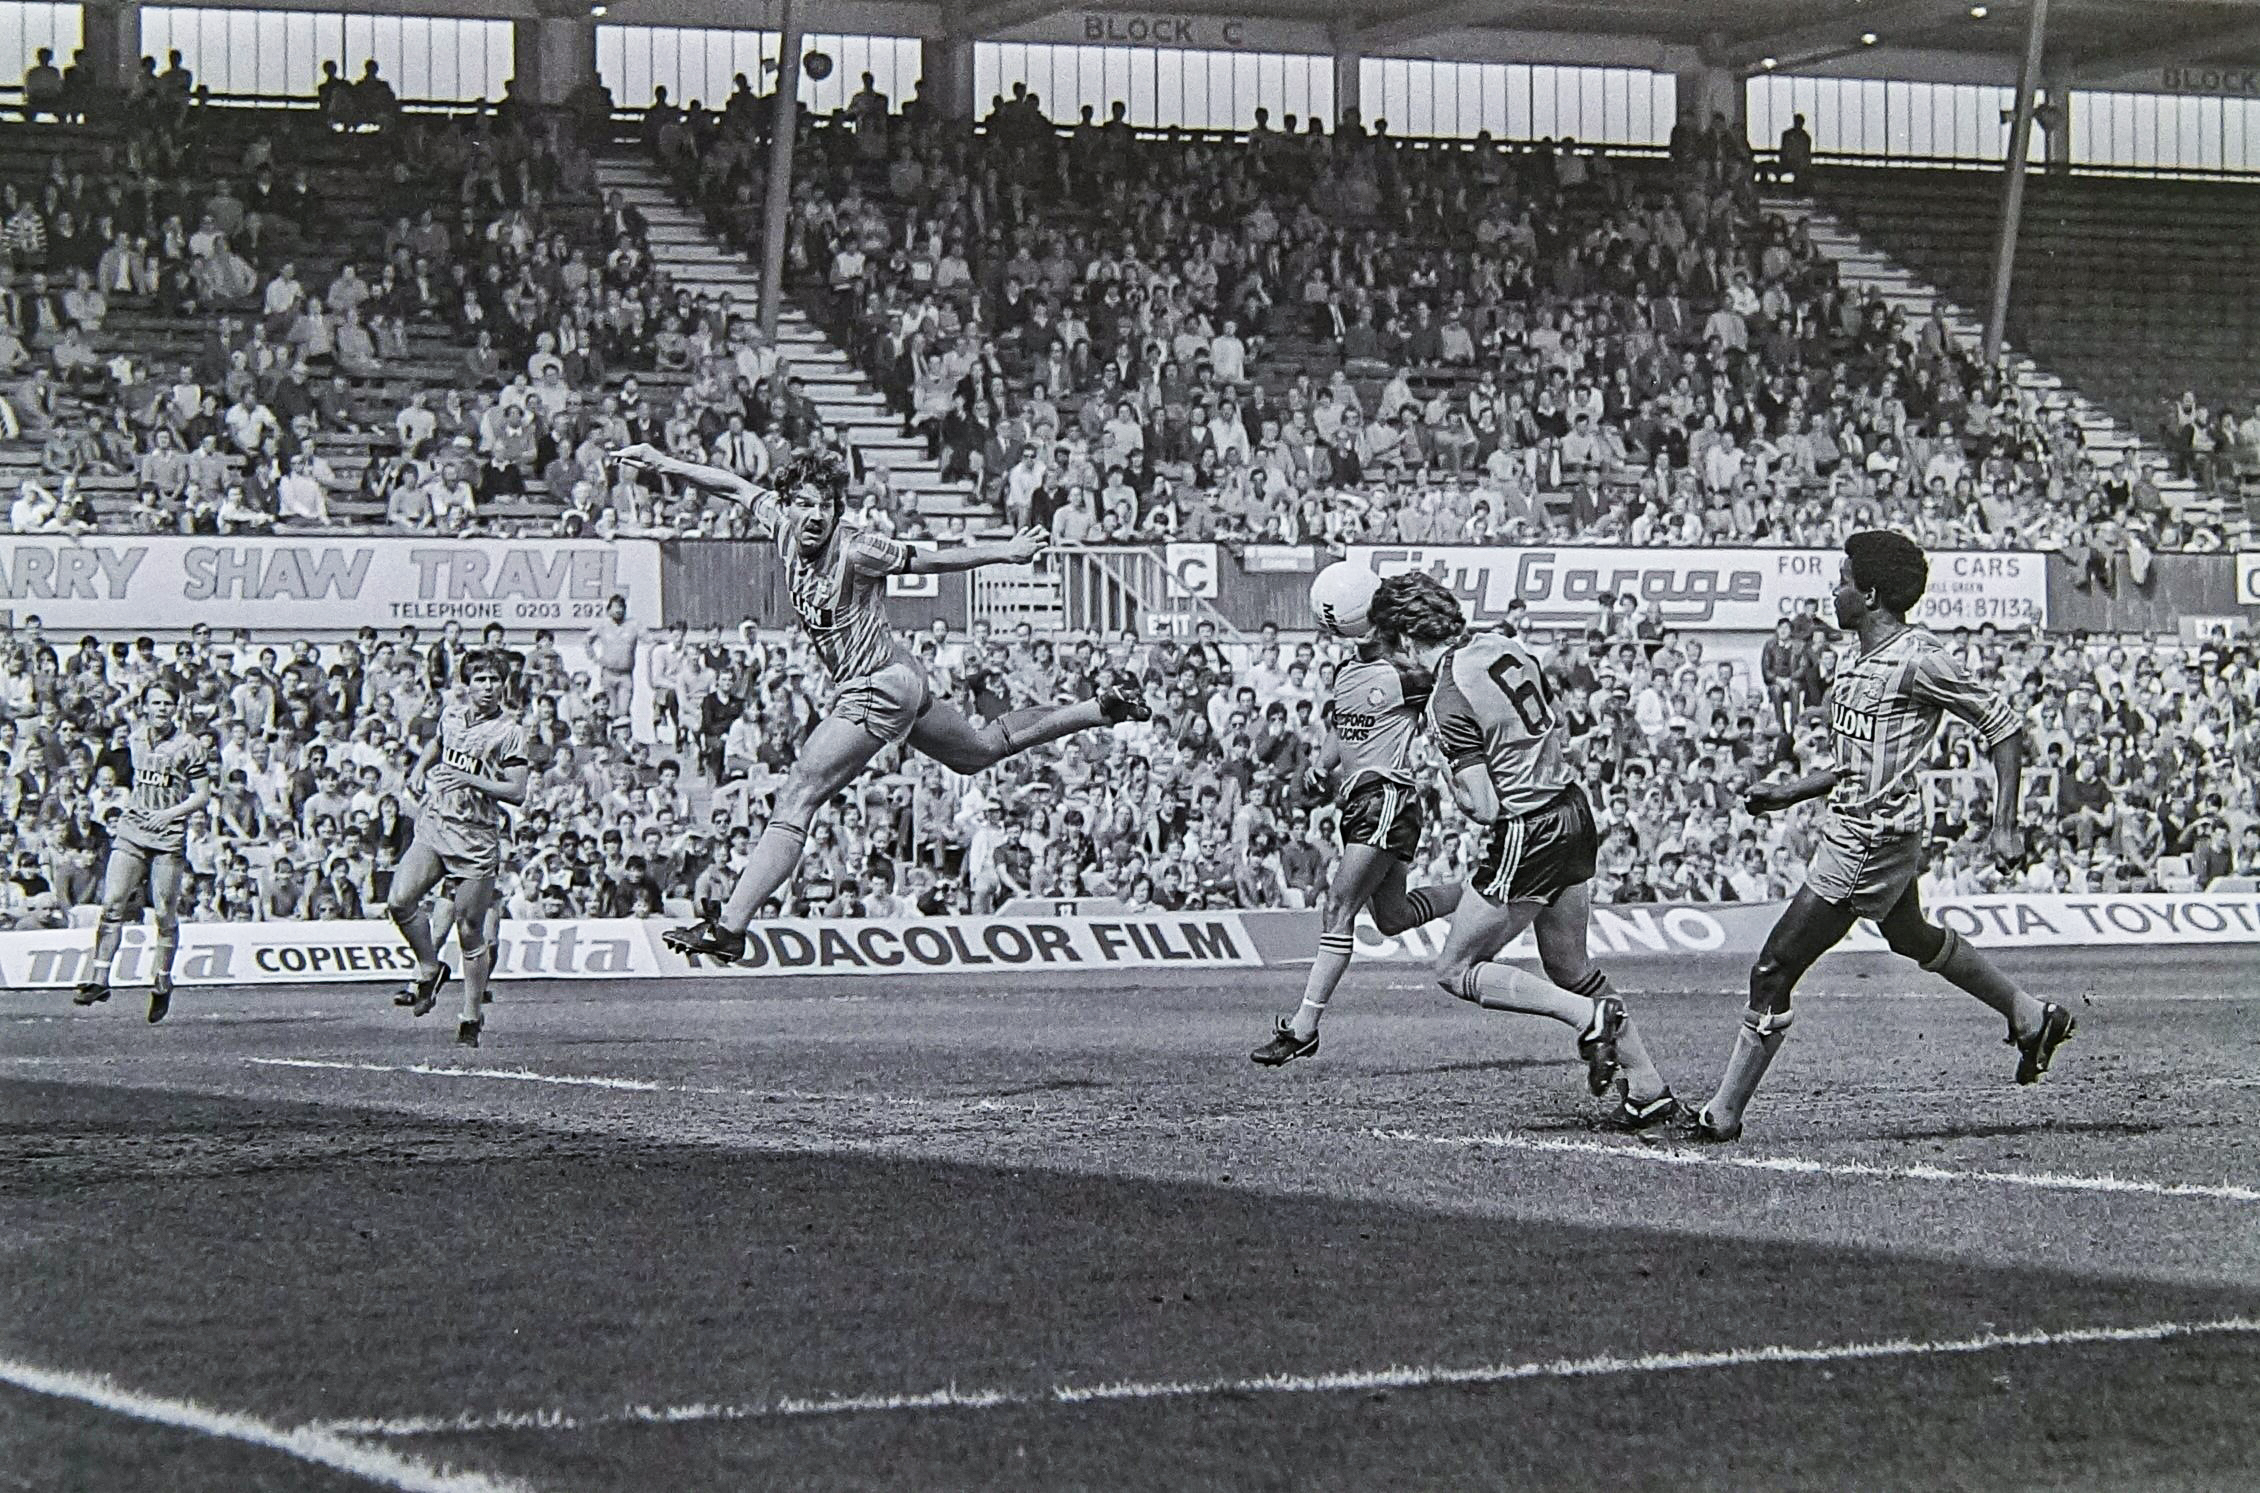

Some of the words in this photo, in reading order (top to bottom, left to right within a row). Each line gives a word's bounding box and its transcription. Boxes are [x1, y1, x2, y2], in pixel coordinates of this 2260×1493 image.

[1085, 15, 1194, 44] BLOCK
[1222, 22, 1243, 45] C
[183, 547, 375, 600] SHAW
[410, 549, 631, 600] TRAVEL
[1177, 558, 1207, 592] C
[1778, 555, 1822, 576] FOR
[1954, 556, 2021, 578] CARS
[1515, 552, 1763, 622] Garage
[389, 602, 503, 618] TELEPHONE
[516, 602, 561, 618] 0203
[1778, 596, 1833, 617] COE
[1488, 653, 1553, 737] 6
[1336, 712, 1376, 728] FORD
[1339, 727, 1370, 741] UCKS
[1832, 701, 1874, 741] LLON
[445, 747, 478, 775] LLON
[136, 769, 170, 787] LLON
[1353, 907, 1726, 957] CINO
[2066, 903, 2260, 934] TOYOT
[27, 928, 236, 983] mia
[256, 945, 416, 973] COPIERS
[687, 923, 1083, 968] ODACOLOR
[1089, 922, 1241, 960] FILM
